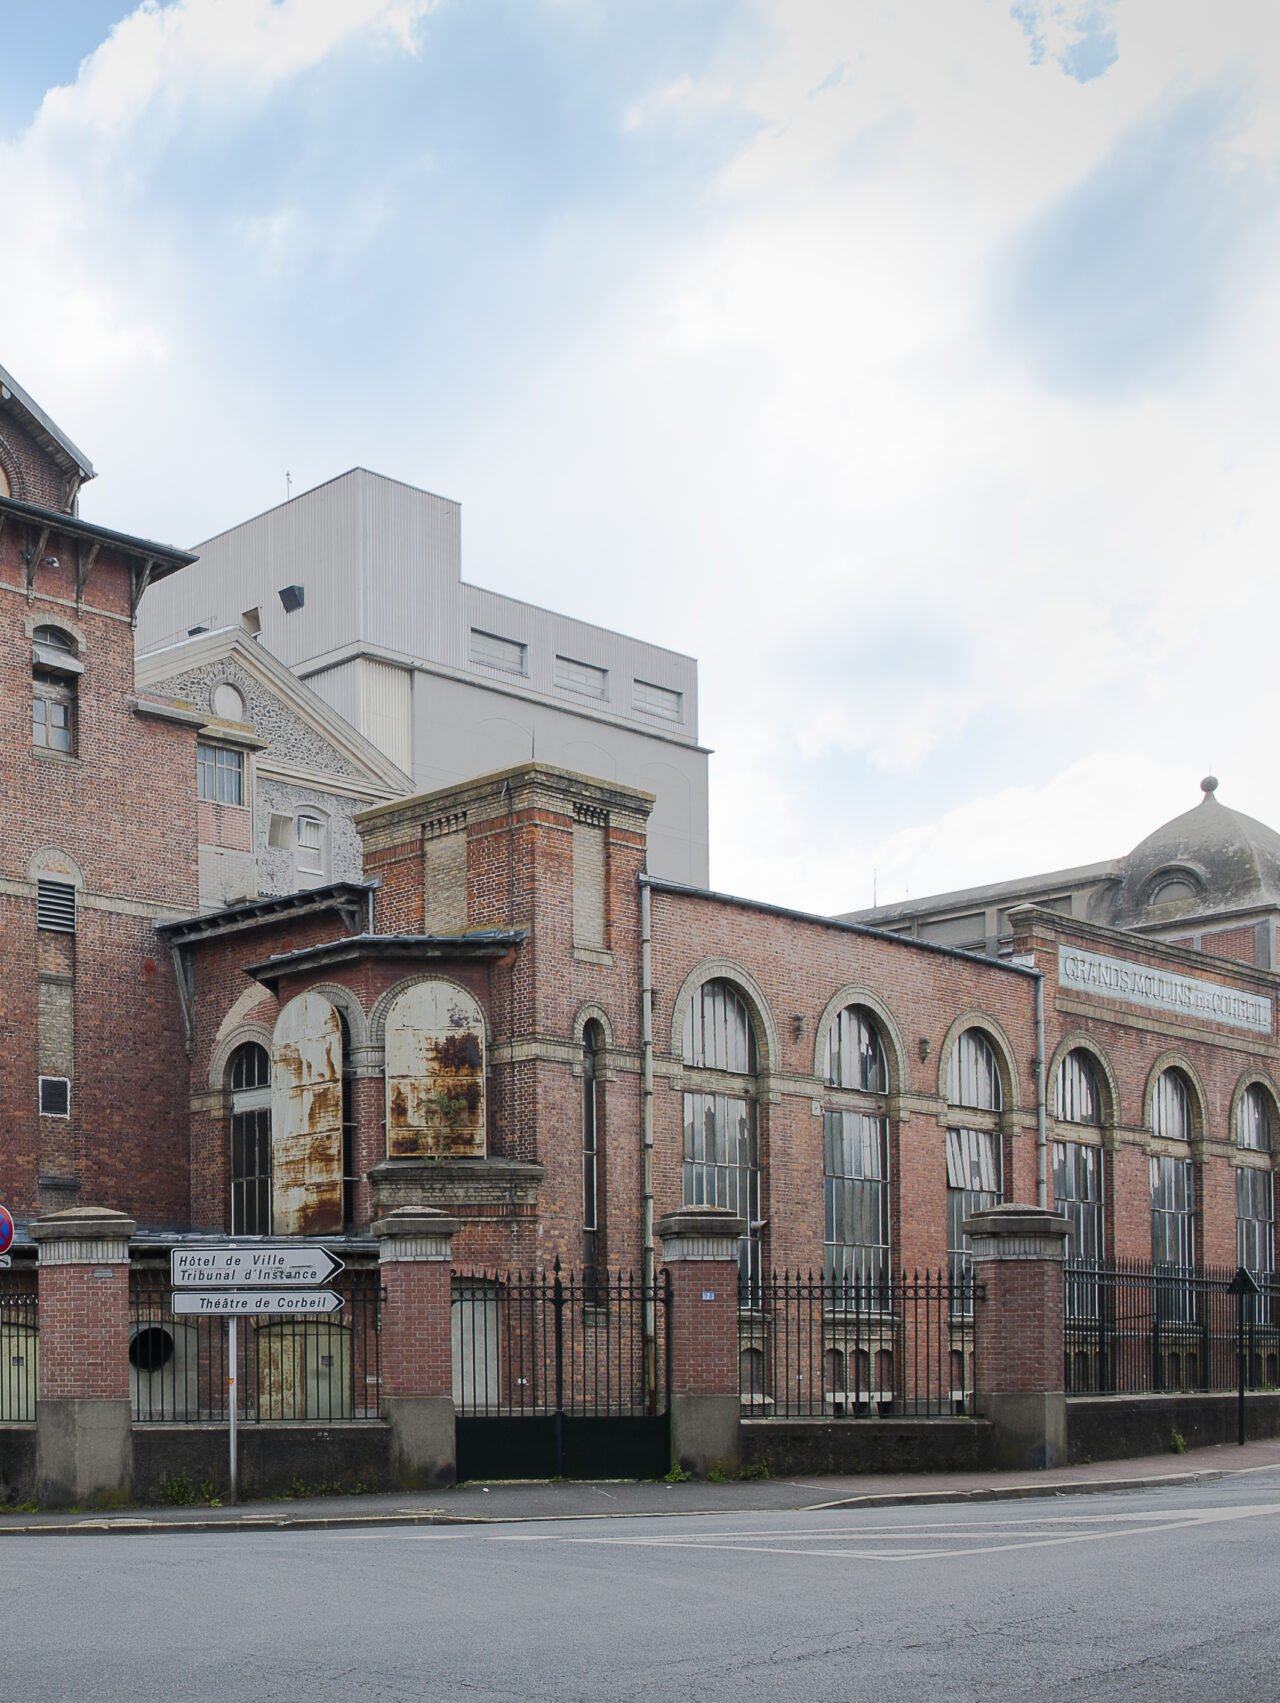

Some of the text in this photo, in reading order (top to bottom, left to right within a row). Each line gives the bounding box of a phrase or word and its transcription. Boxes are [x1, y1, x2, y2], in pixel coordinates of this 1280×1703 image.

[1064, 955, 1129, 992] GRANDS
[1132, 972, 1192, 1007] MOULINS
[1212, 991, 1268, 1026] CORBEIL
[178, 1254, 285, 1266] Hôtel de Ville
[180, 1268, 317, 1281] Tribunal d'Instance
[199, 1296, 327, 1309] Théâtre de Corbeil
